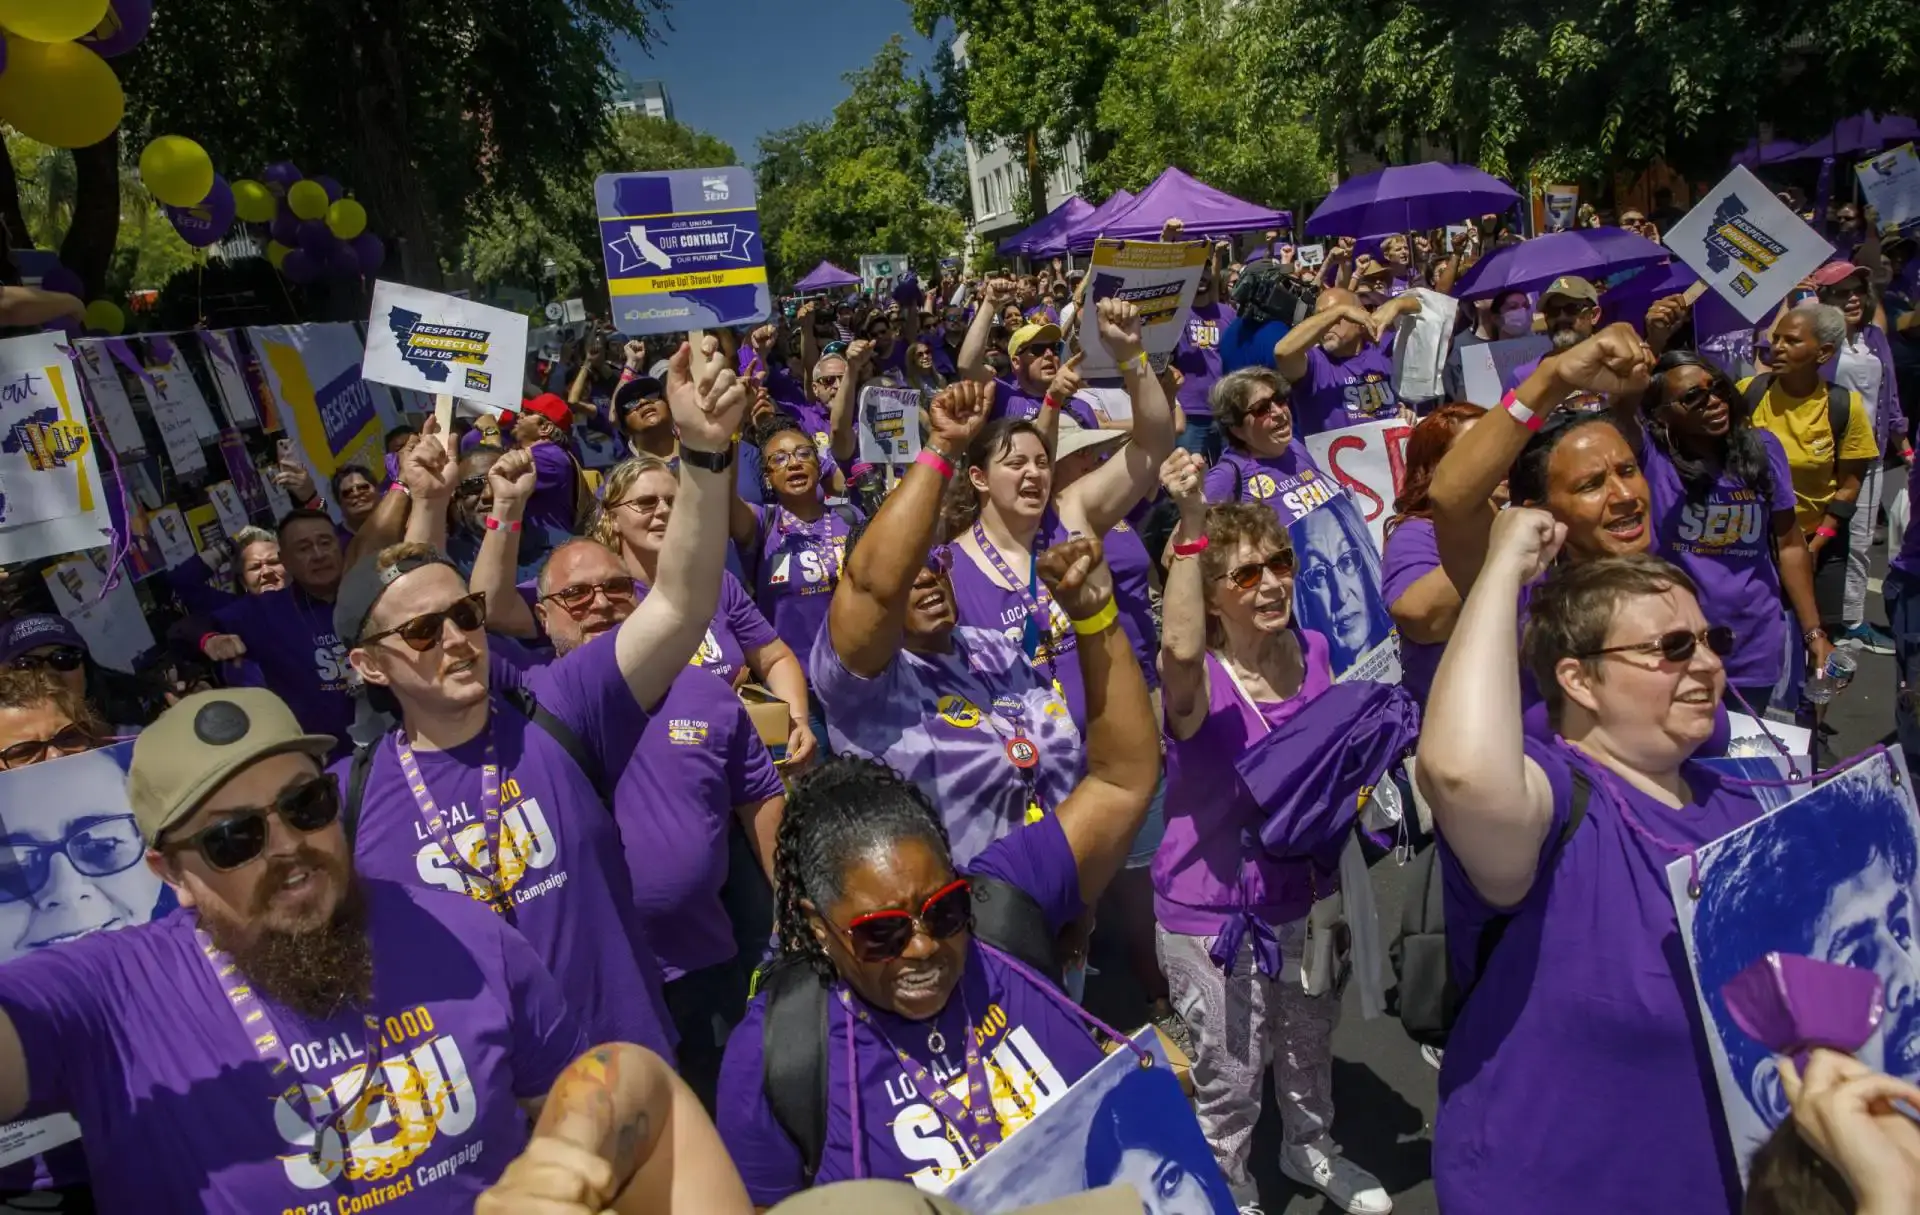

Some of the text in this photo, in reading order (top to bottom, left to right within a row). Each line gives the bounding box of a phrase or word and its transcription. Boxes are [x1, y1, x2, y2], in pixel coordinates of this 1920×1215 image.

[689, 219, 713, 227] UNION
[659, 232, 729, 250] OUR CONTRACT
[1724, 228, 1773, 261] PROTECT US
[1732, 219, 1783, 253] RESPECT US
[1714, 237, 1744, 257] PAY US
[676, 254, 718, 264] OUR FUTURE
[651, 274, 724, 289] Purple Up! Stand Up!
[1119, 283, 1180, 300] RESPECT US
[416, 325, 485, 340] RESPECT US
[413, 348, 453, 359] PAY US
[415, 336, 483, 351] PROTECT US
[1343, 381, 1396, 412] SEIU
[1276, 476, 1301, 492] LOCAL
[1678, 503, 1762, 544] SEIU
[1001, 604, 1028, 625] LOCA
[669, 719, 691, 727] SEIU
[692, 720, 709, 729] 1000
[415, 802, 475, 840] LAL
[515, 870, 568, 904] Campaign
[290, 1032, 365, 1073] OCAL
[885, 1003, 1007, 1106] LOAL 000
[274, 1035, 477, 1190] SEIU
[337, 1174, 415, 1215] Contract
[416, 1140, 484, 1187] Campaign
